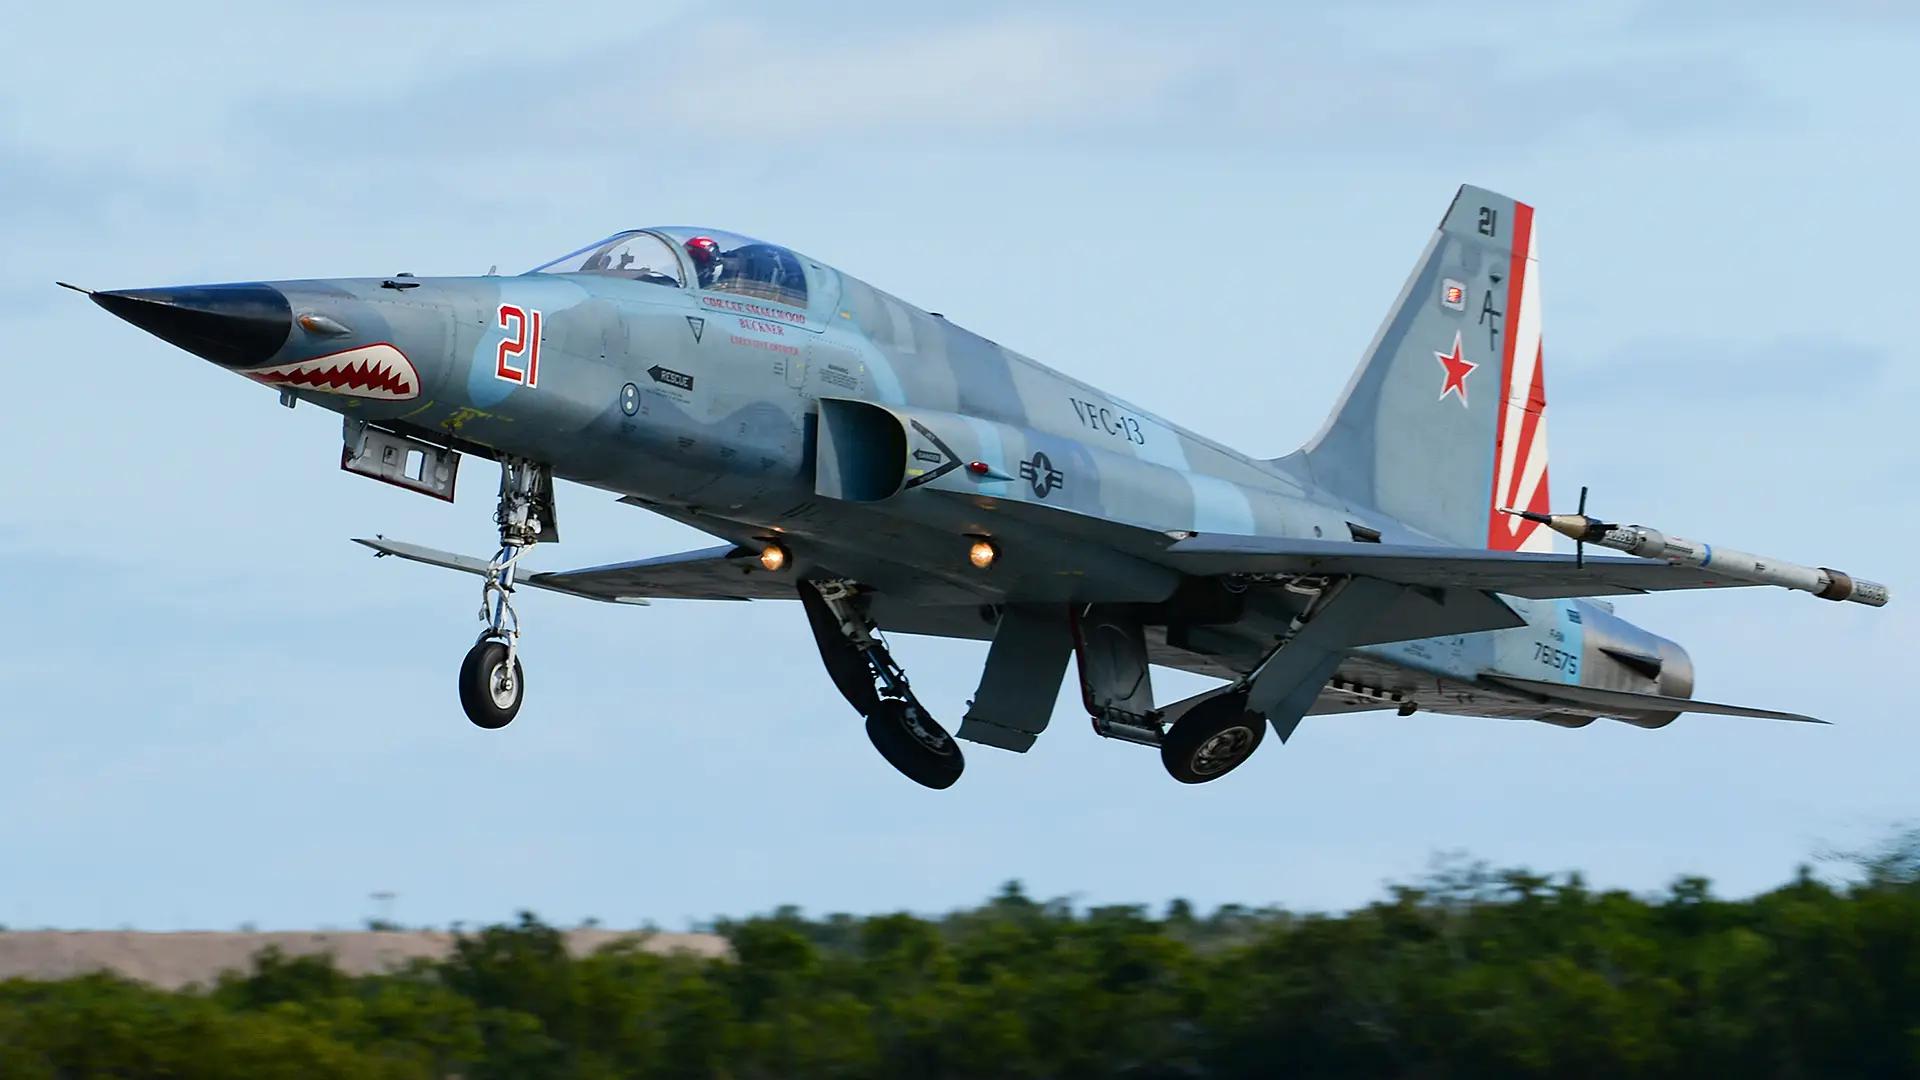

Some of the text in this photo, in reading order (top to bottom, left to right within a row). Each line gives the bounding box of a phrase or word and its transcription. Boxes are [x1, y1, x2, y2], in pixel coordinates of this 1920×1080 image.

[1478, 206, 1497, 237] 21
[495, 303, 542, 388] 21
[660, 370, 690, 388] RESCUE
[1068, 397, 1145, 445] VFC-13
[1534, 641, 1578, 675] 761575
